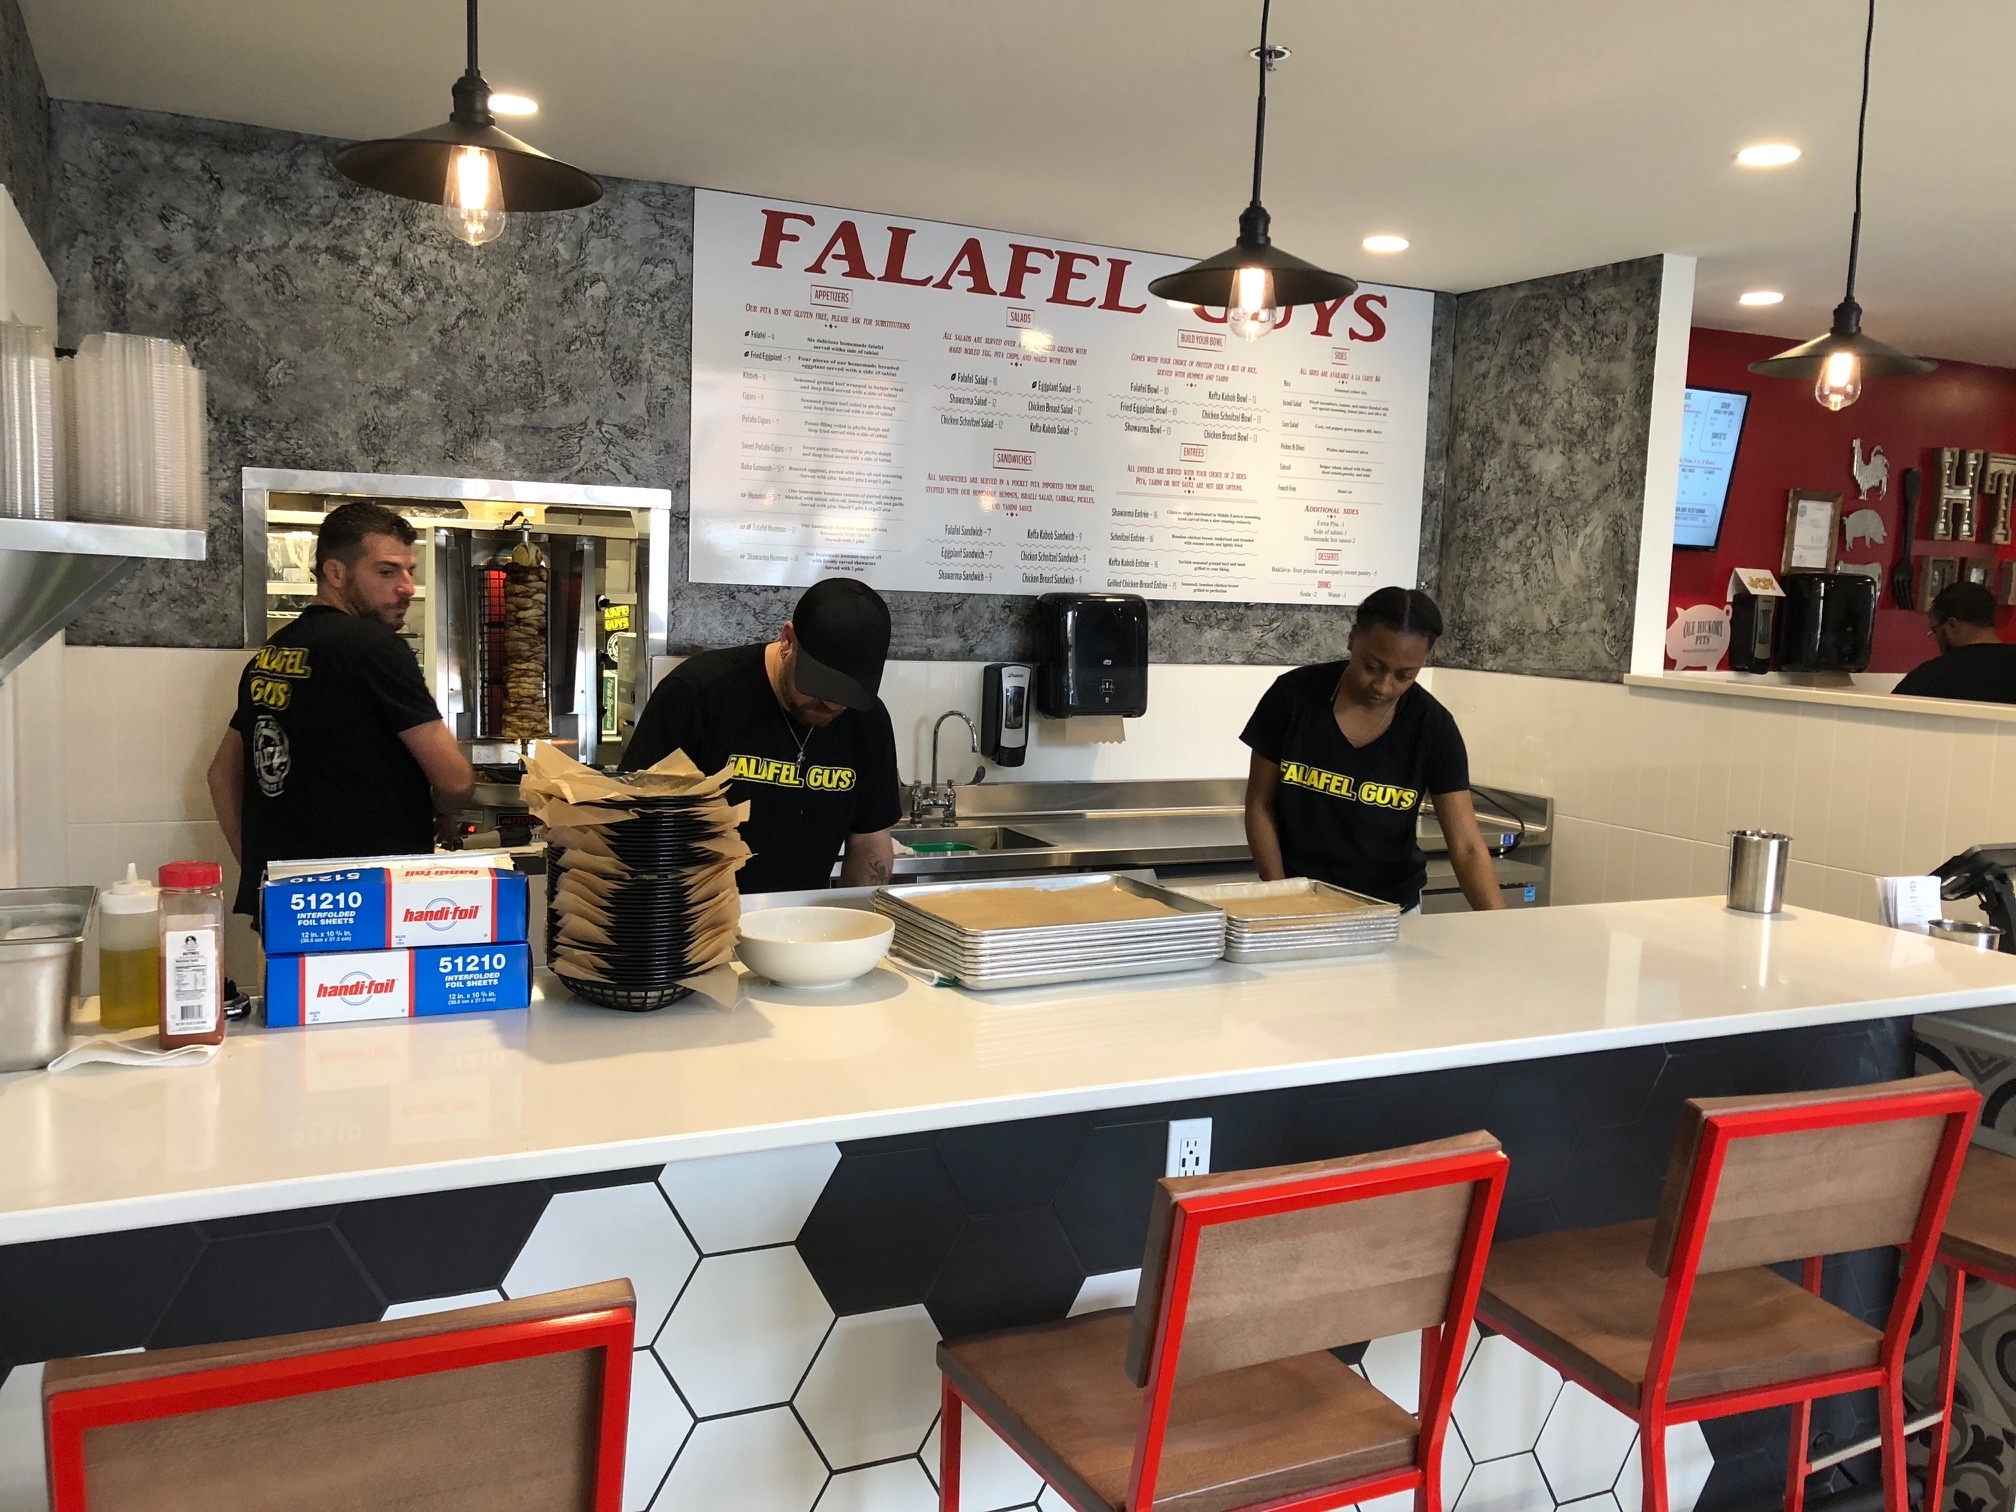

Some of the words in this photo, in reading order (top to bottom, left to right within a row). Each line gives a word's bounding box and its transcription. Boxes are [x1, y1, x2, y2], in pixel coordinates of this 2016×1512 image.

[752, 209, 1147, 314] FALAFEL
[814, 289, 849, 303] APPETIZERS
[1010, 311, 1031, 323] SALADS
[1180, 333, 1195, 343] BUILD
[1196, 334, 1209, 345] YOUR
[1209, 336, 1222, 347] BOWL
[1334, 350, 1347, 360] SIDES
[957, 372, 973, 383] Falafel
[974, 374, 988, 385] Salad
[1037, 380, 1058, 393] Eggplant
[1058, 382, 1071, 393] Salad
[1130, 382, 1146, 393] Falafel
[1146, 384, 1159, 394] Bowl
[949, 393, 973, 405] Shawarma
[973, 395, 987, 406] Salad
[1208, 390, 1221, 400] Kefta
[1221, 391, 1235, 402] Kabob
[1236, 393, 1247, 402] Bowl
[1027, 400, 1045, 411] Chicken
[1045, 402, 1060, 413] Breast
[1060, 403, 1073, 414] Salad
[1120, 401, 1132, 412] Fried
[1132, 402, 1155, 414] Eggplant
[1155, 404, 1167, 414] Bowl
[940, 414, 959, 425] Chicken
[959, 415, 980, 427] Schnitzel
[980, 417, 994, 428] Salad
[1201, 409, 1219, 419] Chicken
[1220, 410, 1240, 422] Schnitzel
[1241, 412, 1252, 422] Bowl
[1029, 422, 1041, 432] Kefta
[1042, 423, 1056, 434] Kabob
[1056, 424, 1069, 435] Salad
[1124, 421, 1149, 433] Shawarma
[1149, 424, 1162, 434] Bowl
[1203, 429, 1221, 439] Chicken
[1221, 430, 1236, 441] Breast
[1237, 432, 1248, 441] Bowl
[996, 452, 1032, 465] SANDWICHES
[1303, 505, 1339, 514] ADDITIONAL
[944, 524, 960, 535] Falafel
[960, 525, 982, 536] Sandwich
[1026, 528, 1039, 539] Kefta
[1039, 529, 1053, 540] Kabob
[1053, 529, 1074, 541] Sandwich
[940, 546, 962, 559] Eggplant
[962, 547, 984, 559] Sandwich
[1020, 550, 1037, 561] Chicken
[1038, 551, 1058, 562] Schnitzel
[1057, 552, 1078, 563] Sandwich
[1317, 552, 1339, 561] DESSERTS
[938, 569, 962, 580] Shawarma
[962, 570, 984, 581] Sandwich
[1021, 572, 1039, 583] Chicken
[1039, 573, 1053, 583] Breast
[1053, 573, 1074, 584] Sandwich
[1697, 620, 1724, 637] HICKORY
[1696, 636, 1710, 645] PITS
[728, 756, 802, 786] ALAFEL
[808, 767, 854, 790] GUYS
[1360, 783, 1416, 809] GUYS
[290, 892, 362, 910] 51210
[297, 910, 356, 919] INTERFOLDED
[320, 918, 354, 926] SHEETS
[439, 954, 506, 973] 51210
[445, 972, 500, 981] INTERFOLDED
[466, 979, 498, 987] SHEETS
